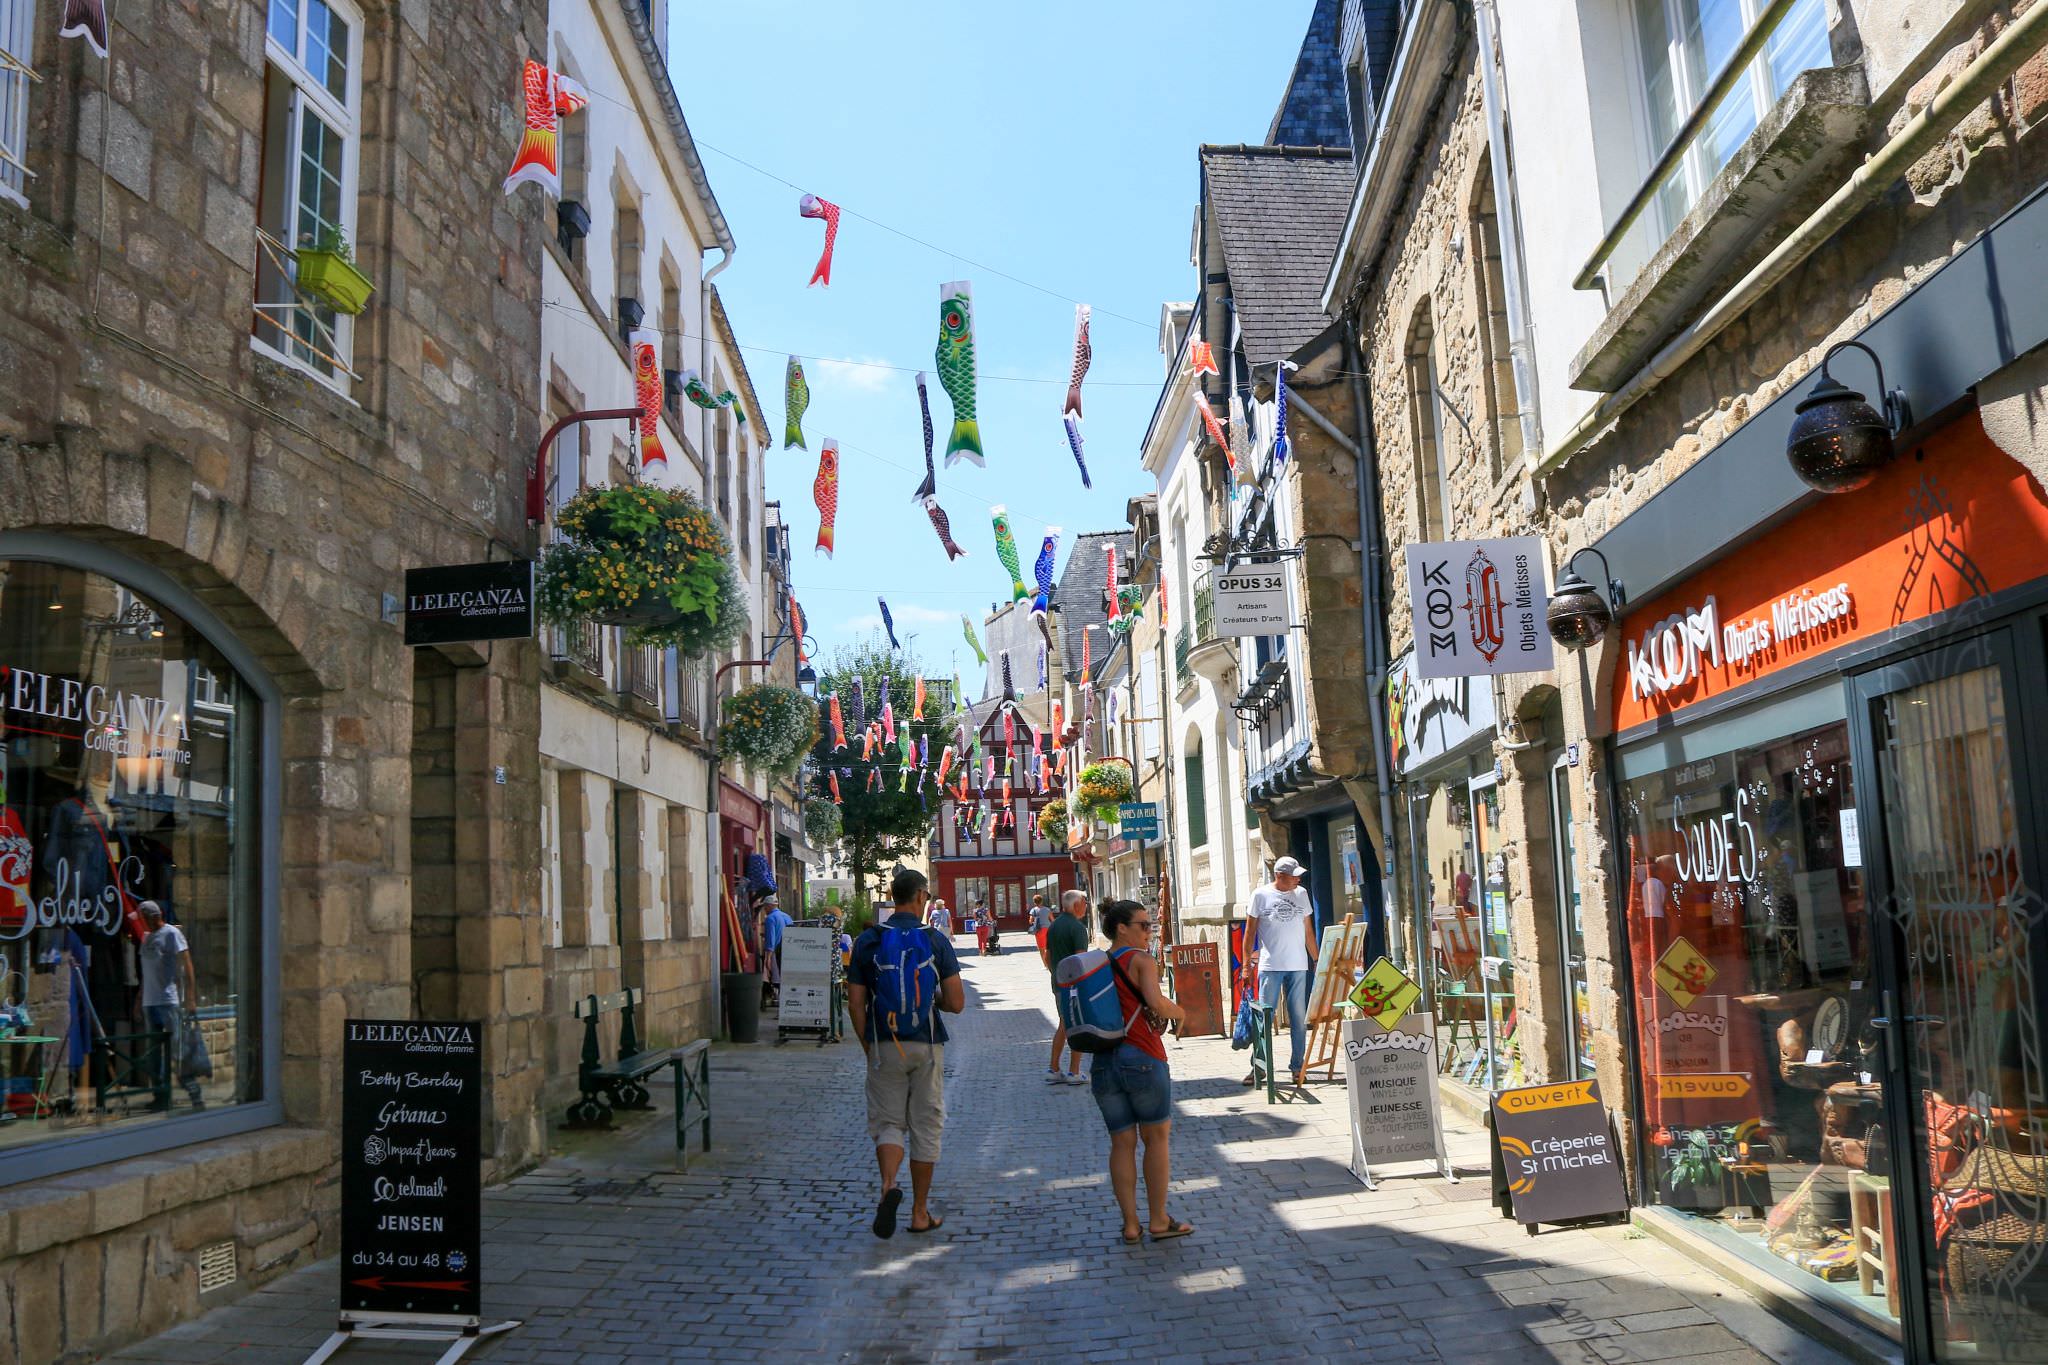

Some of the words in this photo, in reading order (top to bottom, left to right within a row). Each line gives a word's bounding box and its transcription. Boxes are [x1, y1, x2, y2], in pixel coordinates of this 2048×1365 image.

[1218, 578, 1261, 590] OPUS
[1264, 577, 1282, 589] 34
[1514, 554, 1531, 609] Métisses
[460, 606, 497, 617] Collection
[498, 605, 527, 616] femme
[1421, 560, 1457, 658] KOOM
[1519, 612, 1538, 652] Objets
[1723, 618, 1771, 667] Objets
[1771, 583, 1852, 644] Métisses
[0, 664, 192, 742] 'ELEGANZA
[1673, 787, 1756, 883] SOLDES
[1177, 946, 1214, 965] GALERIE
[404, 1042, 444, 1052] Collection
[445, 1043, 475, 1054] femme
[1383, 1054, 1398, 1063] BD
[360, 1069, 401, 1093] Betty
[404, 1071, 463, 1094] Barclay
[1369, 1076, 1417, 1090] MUSIQUE
[1367, 1101, 1423, 1114] JEUNESSE
[1510, 1087, 1581, 1108] ouvert
[425, 1138, 457, 1162] Jeans
[1531, 1132, 1606, 1154] Crêperie
[1521, 1159, 1539, 1175] St
[377, 1215, 444, 1232] JENSEN
[352, 1250, 373, 1265] du
[376, 1251, 395, 1266] 34
[398, 1254, 418, 1266] au
[422, 1253, 440, 1267] 48
